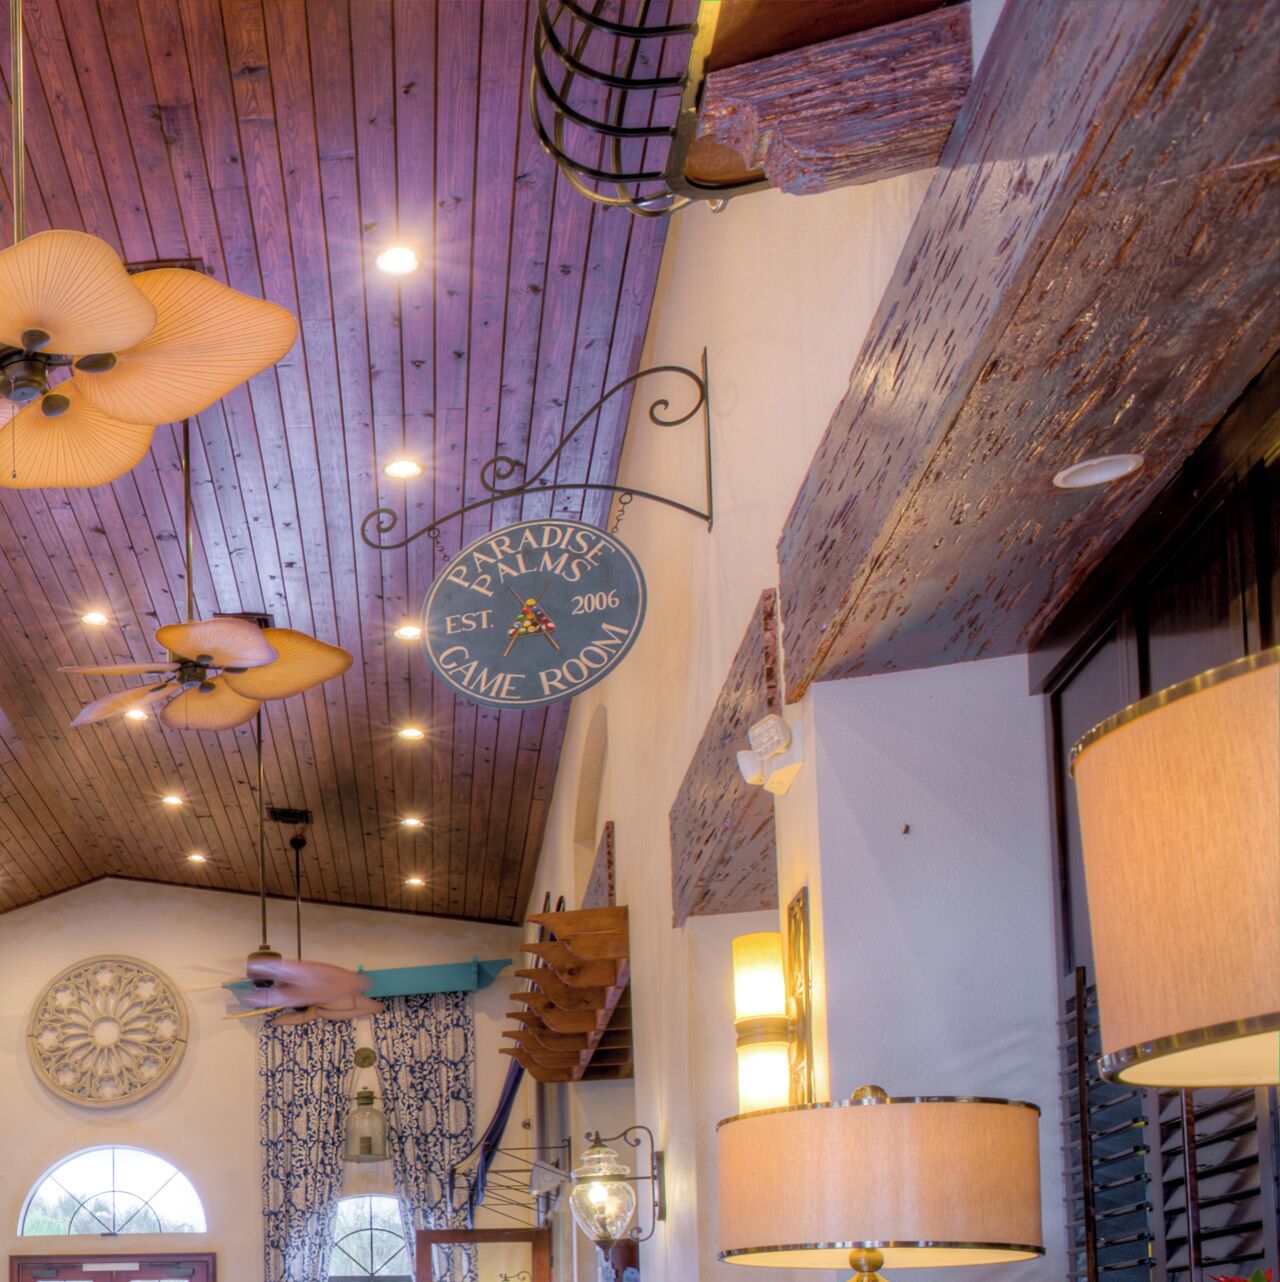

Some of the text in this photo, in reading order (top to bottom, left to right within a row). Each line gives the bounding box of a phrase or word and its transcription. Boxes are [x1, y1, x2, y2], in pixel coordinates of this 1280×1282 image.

[446, 525, 616, 588] PARADISE
[469, 550, 592, 598] PALMS
[445, 609, 495, 635] EST.
[571, 589, 620, 616] 2006
[439, 622, 630, 700] GAME ROOM
